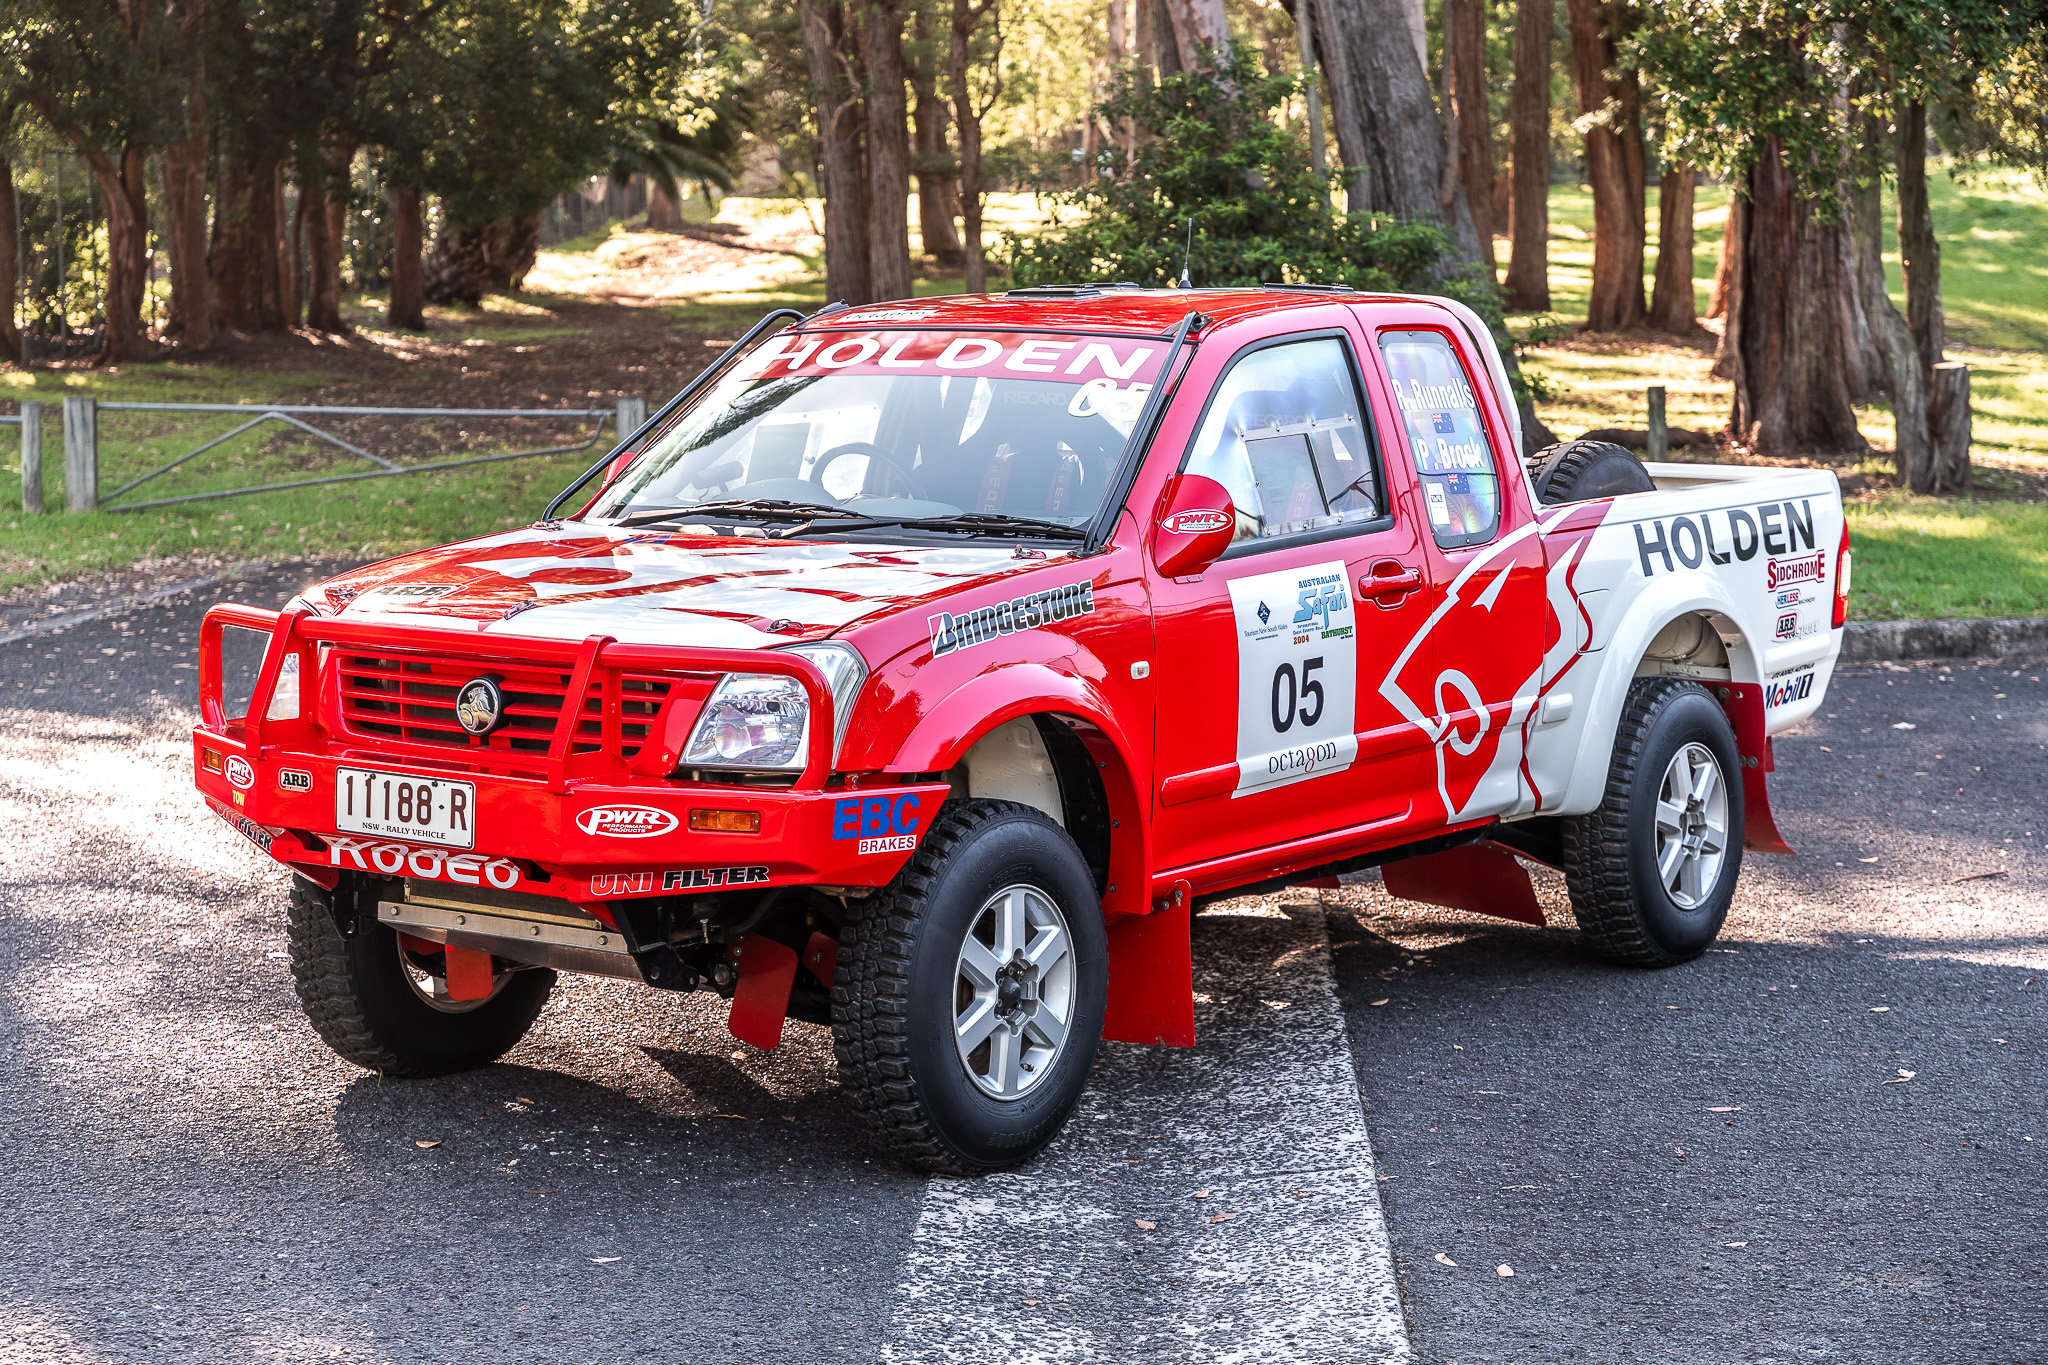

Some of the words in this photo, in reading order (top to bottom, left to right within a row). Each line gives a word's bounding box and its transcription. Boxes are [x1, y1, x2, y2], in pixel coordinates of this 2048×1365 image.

[757, 337, 1154, 379] HOLDEN
[1004, 390, 1067, 407] RECARO
[1409, 377, 1475, 410] Runnalls
[1172, 513, 1223, 532] PWR
[1633, 499, 1815, 577] HOLDEN
[1298, 574, 1341, 589] AUSTRALIAN
[1768, 553, 1825, 589] SIDCHROME
[927, 579, 1096, 658] BRIDGESTONE
[1321, 625, 1353, 640] BATHURST
[1778, 616, 1795, 634] ARB
[1293, 634, 1310, 646] 2004
[1271, 656, 1324, 734] 05
[1766, 676, 1802, 710] Mobil
[226, 758, 250, 782] PWR
[1268, 741, 1337, 774] octagon
[282, 772, 309, 788] ARB
[232, 789, 245, 807] TOW
[362, 822, 380, 831] NSW
[386, 826, 410, 836] RALLY
[412, 828, 446, 840] VEHICLE
[587, 810, 665, 836] PWR
[832, 794, 920, 840] EBC
[237, 817, 272, 854] FILTER
[859, 836, 916, 854] BRAKES
[329, 837, 521, 890] RODEO
[590, 871, 654, 896] UNI
[660, 866, 770, 892] FILTER
